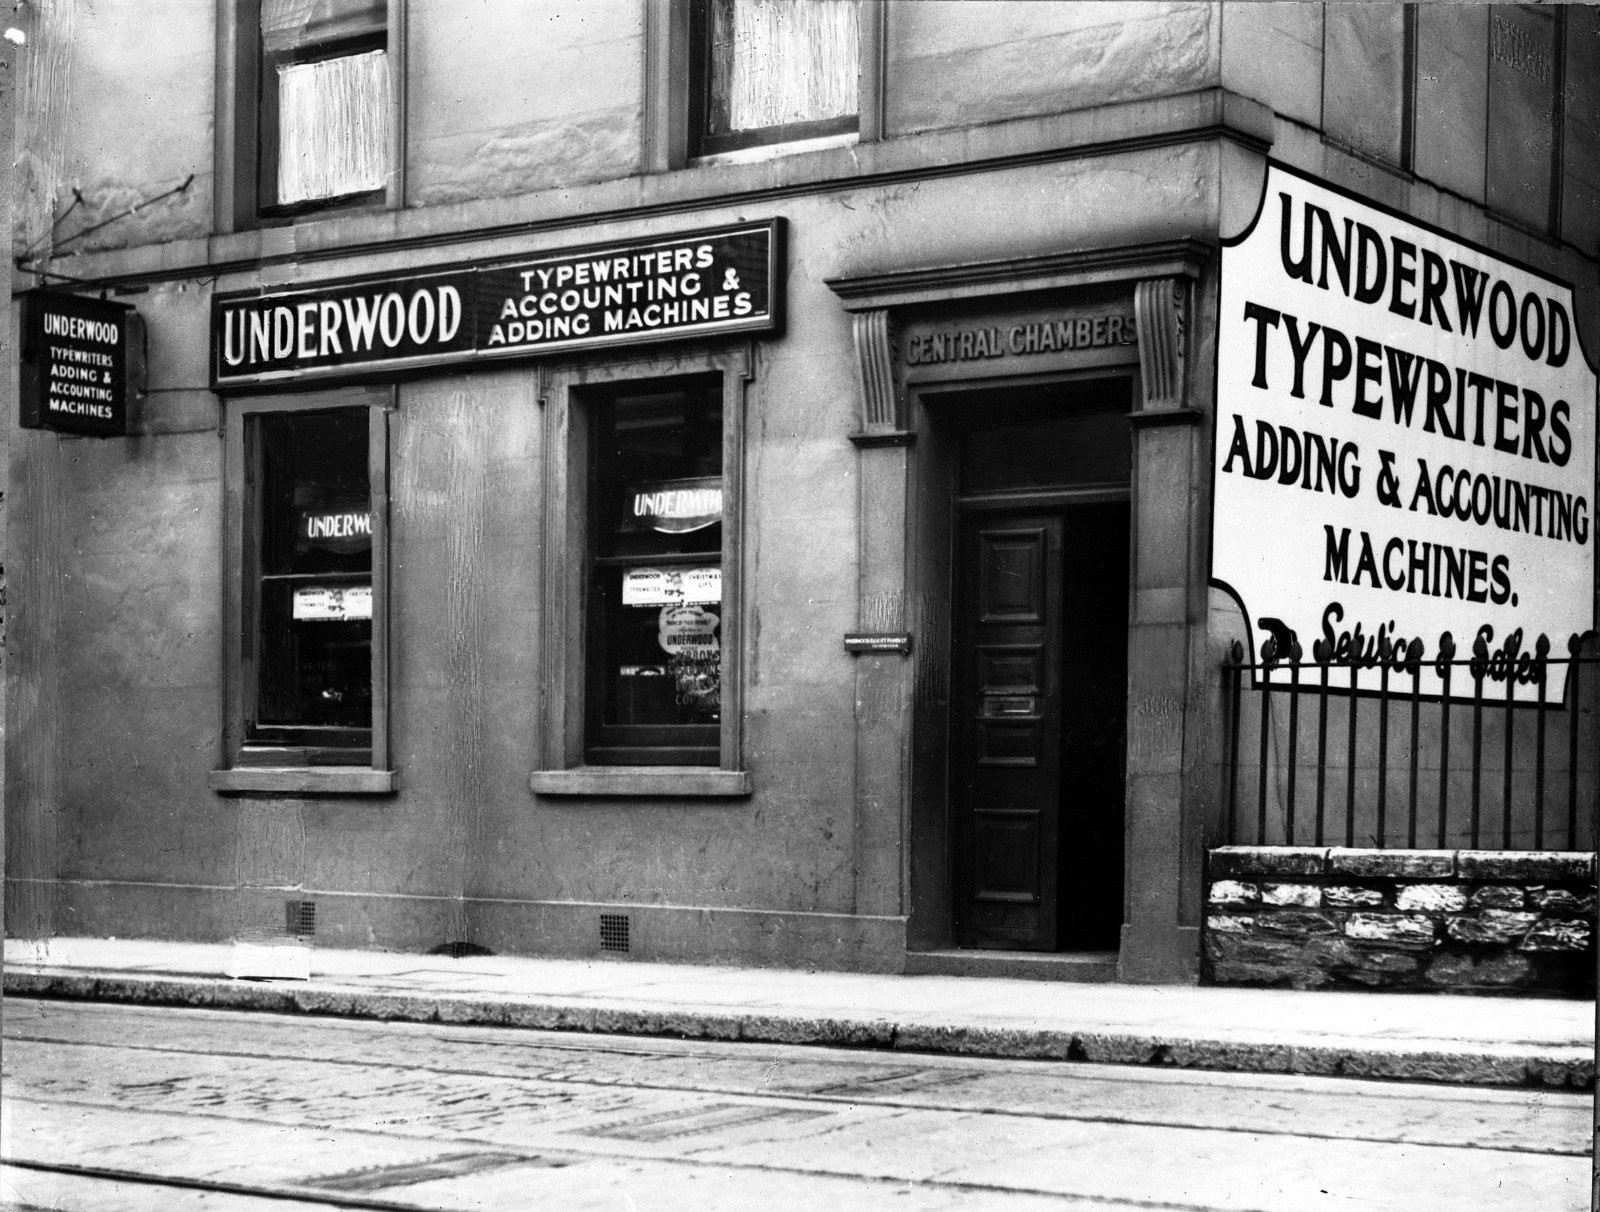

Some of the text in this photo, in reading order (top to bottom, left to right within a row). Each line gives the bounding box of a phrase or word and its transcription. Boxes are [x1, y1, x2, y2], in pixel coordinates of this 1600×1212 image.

[500, 267, 740, 320] ACCOUNTING &
[520, 245, 714, 292] TYPEWRITERS
[1279, 191, 1571, 368] UNDERWOOD
[44, 312, 118, 345] UNDERWOOD
[224, 285, 462, 366] UNDERWOOD
[488, 292, 752, 346] ADDING MACHINES
[907, 316, 1138, 366] CENTRAL CHAMBERS
[50, 346, 113, 367] TYPEWRITERS
[50, 363, 112, 384] ADDING &
[49, 398, 113, 419] MACHINES
[50, 381, 113, 402] ACCOUNTING
[1243, 301, 1573, 468] TYPEWRITERS
[1222, 413, 1590, 545] ADDING & ACCOUNTING
[1323, 524, 1519, 608] MACHINES.
[666, 633, 714, 646] UNDERWOOD
